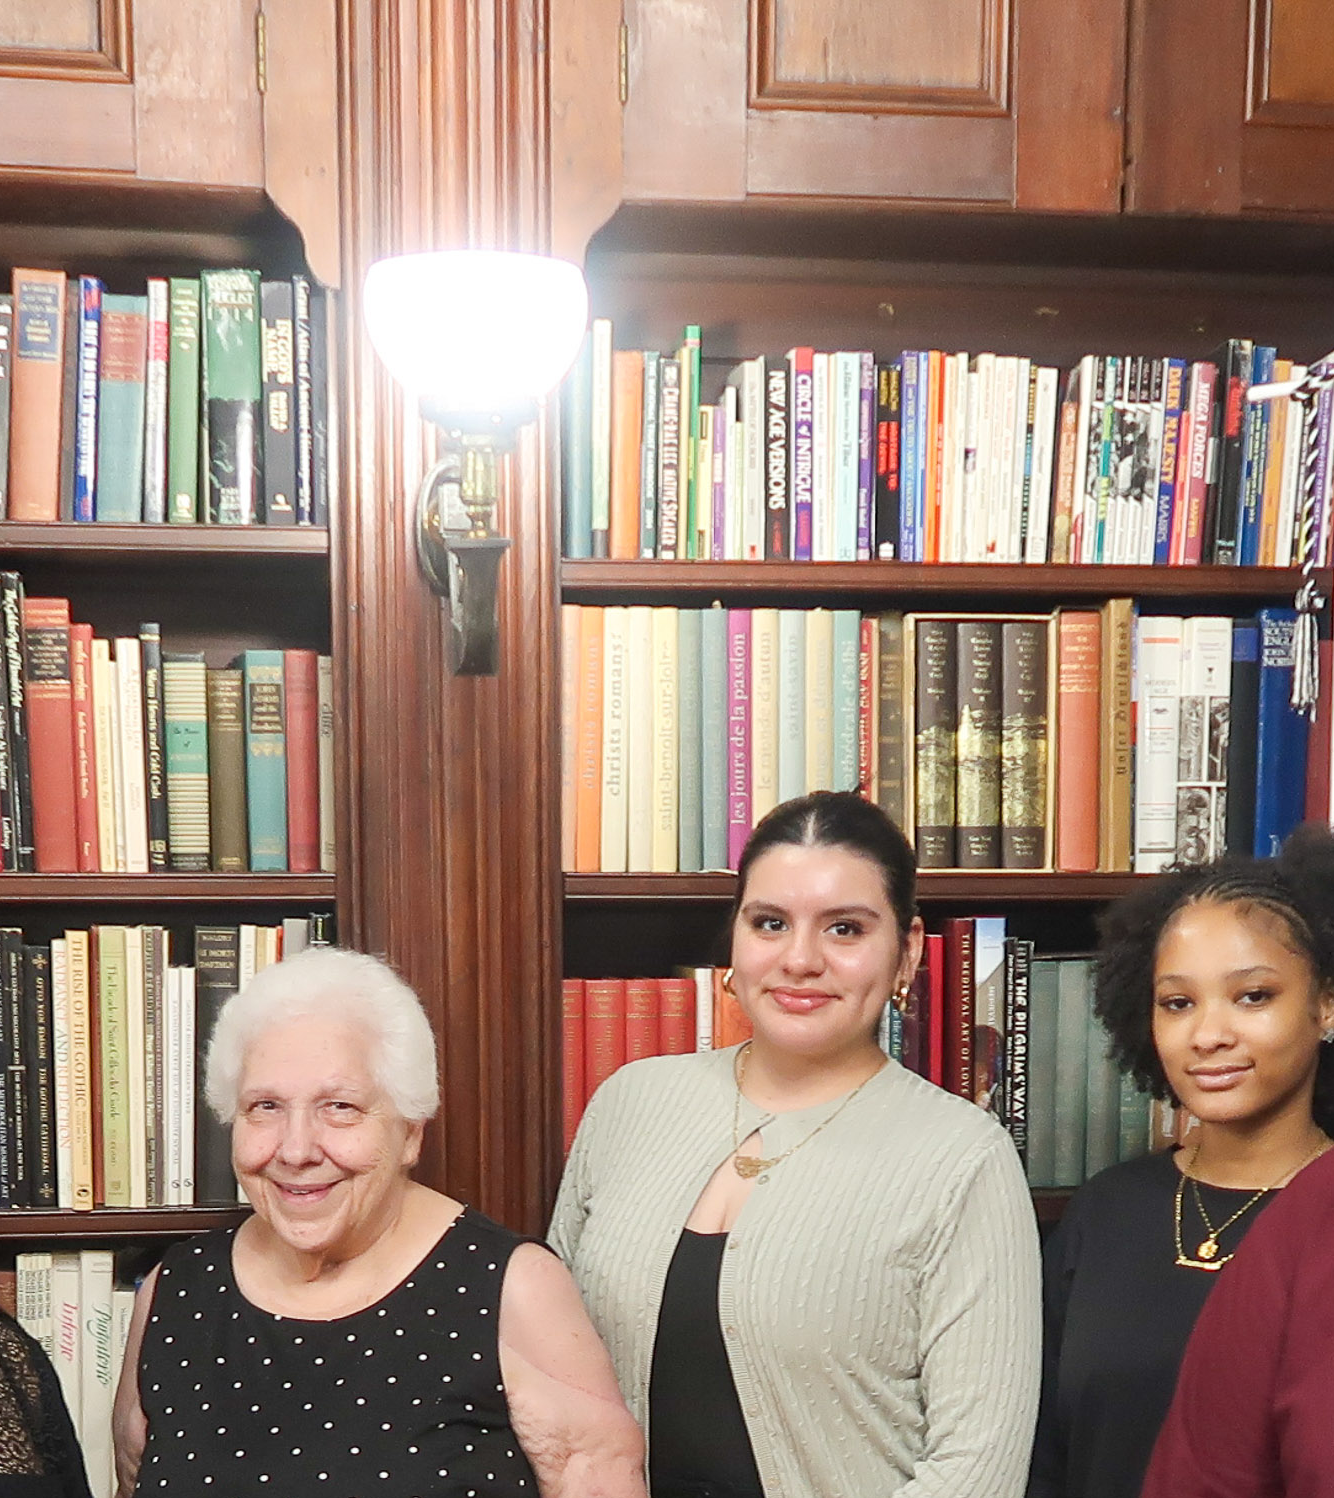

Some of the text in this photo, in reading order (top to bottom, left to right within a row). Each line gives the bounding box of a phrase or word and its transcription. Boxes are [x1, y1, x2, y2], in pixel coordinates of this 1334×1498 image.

[276, 319, 293, 384] IN GOD'S
[769, 370, 786, 510] NEW AGE VERSIONS
[1160, 366, 1182, 484] DARK MAJESTY
[1192, 382, 1210, 479] MEGA FORCES
[661, 388, 678, 545] CHANG-RAE LEE NATIVE SPEAKER
[730, 632, 747, 824] les jours de la passion
[606, 727, 623, 797] christs
[35, 976, 45, 998] OTTO
[36, 1001, 46, 1023] VON
[960, 933, 970, 1095] THE MEDIEVAL ART OF LOVE
[1013, 976, 1027, 1006] THE
[55, 949, 71, 1149] RADIANCE AND REFLECTION
[72, 938, 87, 1108] THE RISE OF THE GOTHIC
[38, 1068, 48, 1084] THE
[39, 1087, 49, 1122] GOTHIC
[1013, 1088, 1027, 1120] WAY
[40, 1123, 50, 1175] CATHEDRAL
[1, 1184, 9, 1199] ART
